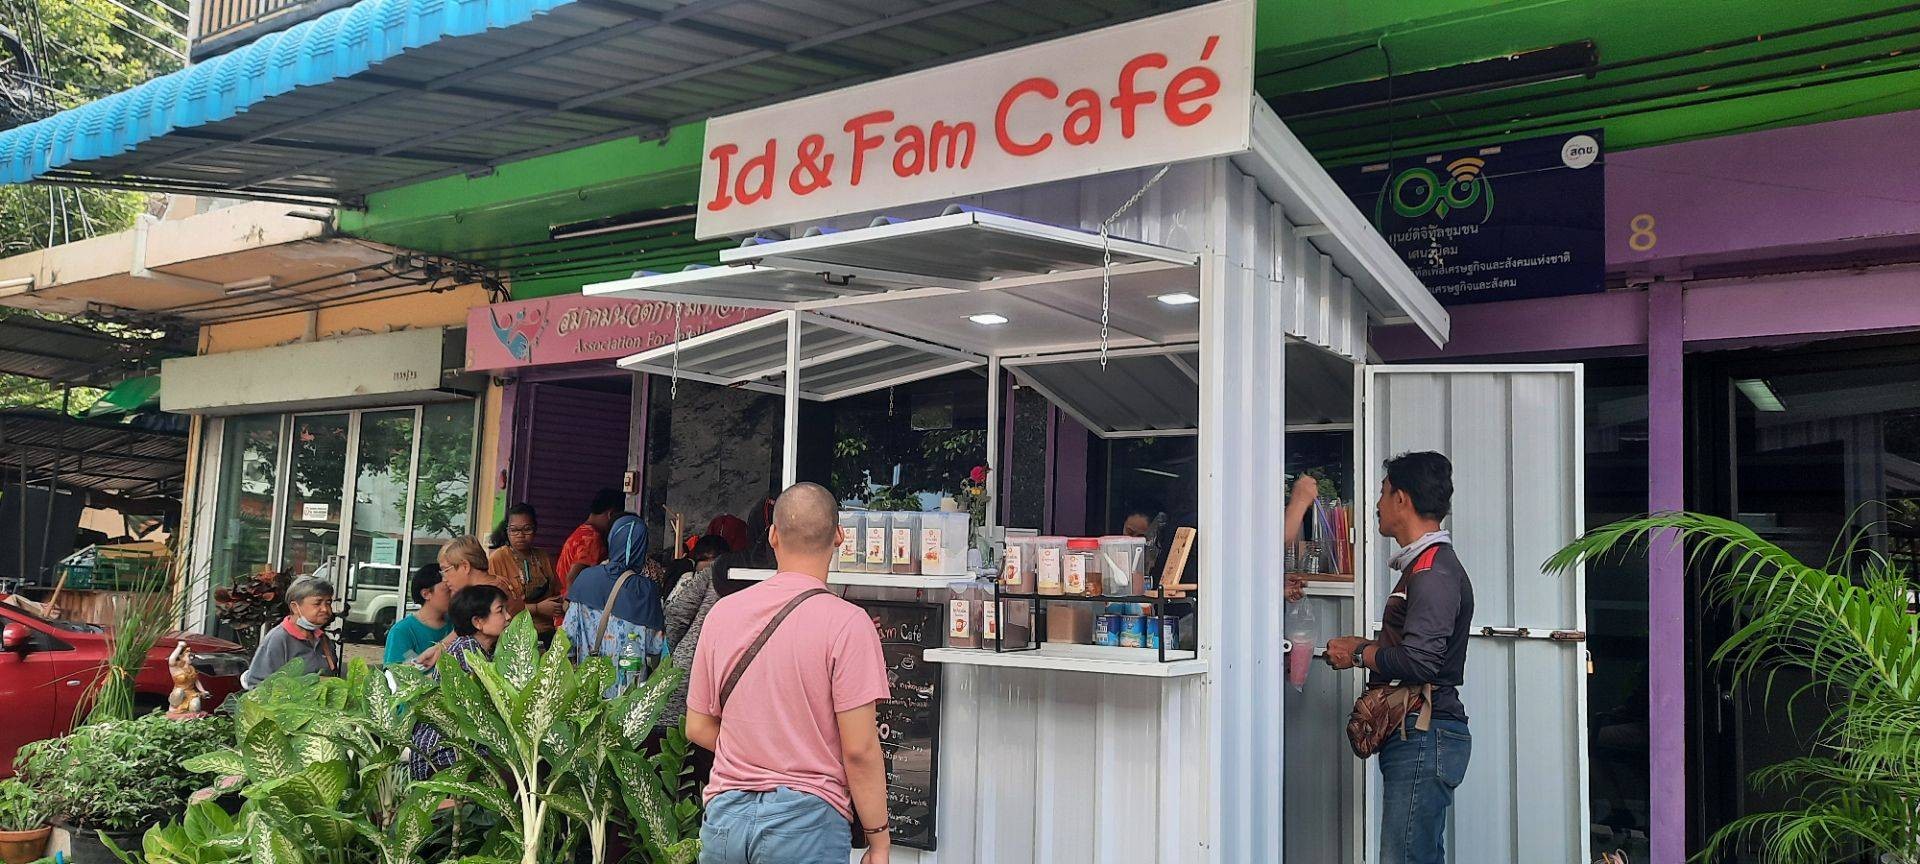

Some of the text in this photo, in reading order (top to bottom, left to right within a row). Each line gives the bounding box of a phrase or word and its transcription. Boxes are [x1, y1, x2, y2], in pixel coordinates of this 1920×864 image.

[707, 36, 1221, 211] Id & Fam Café
[1629, 213, 1657, 251] 8
[574, 336, 642, 353] Association
[647, 330, 669, 347] For
